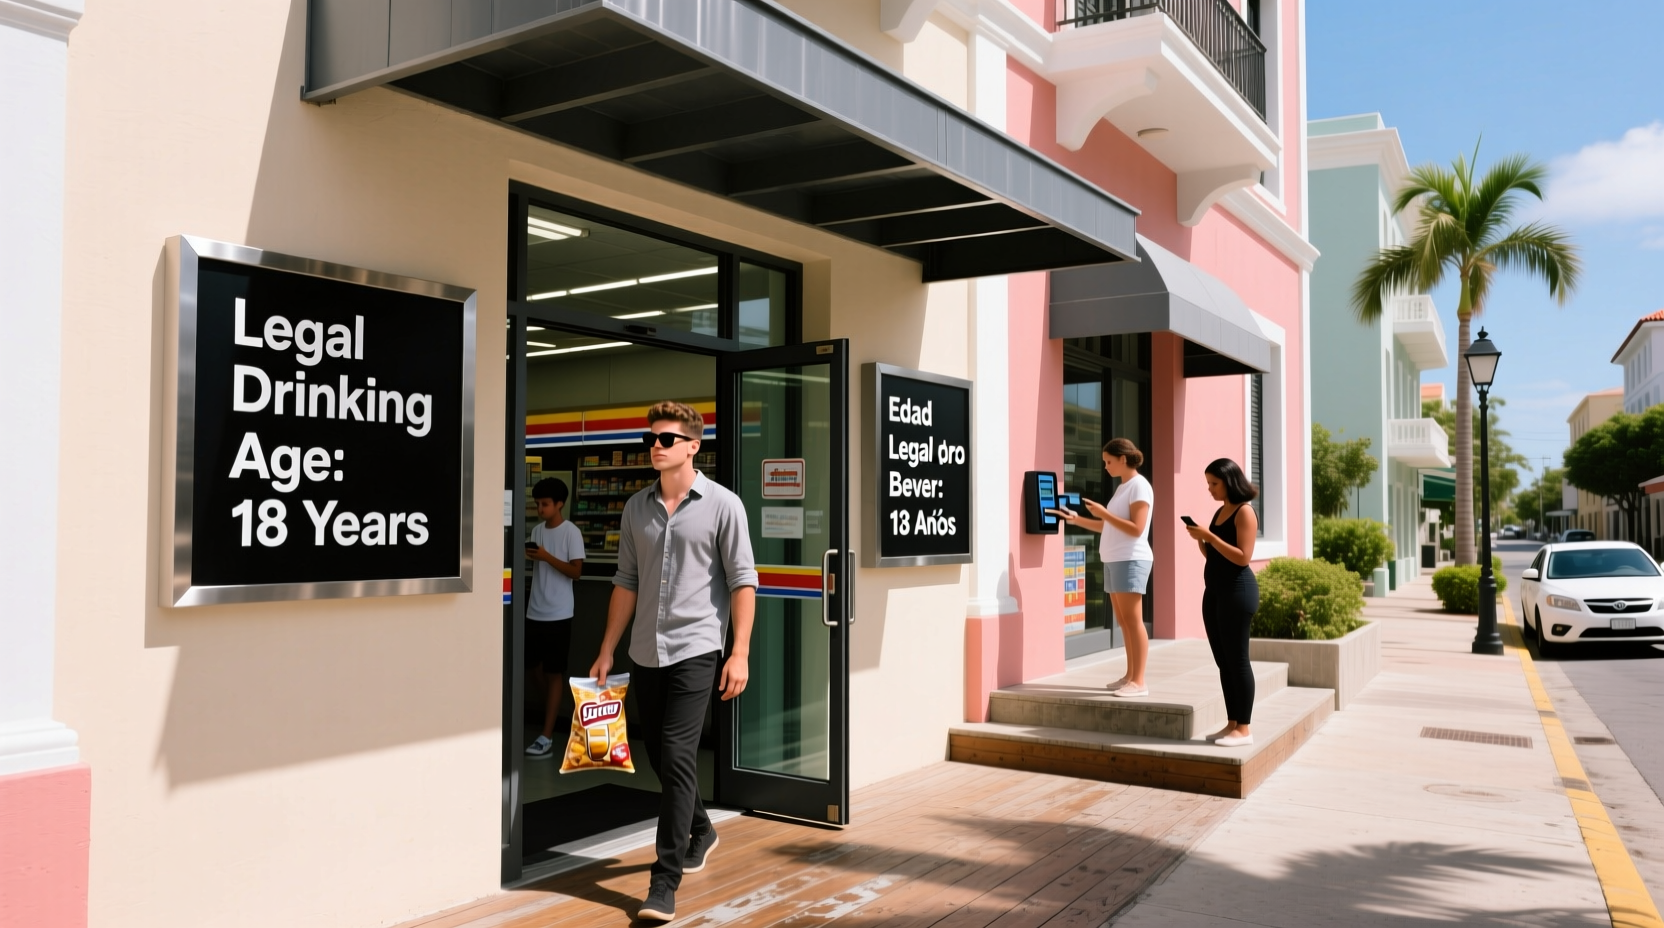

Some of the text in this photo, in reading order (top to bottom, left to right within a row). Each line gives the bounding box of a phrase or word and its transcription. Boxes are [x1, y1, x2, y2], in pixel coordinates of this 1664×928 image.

[234, 297, 365, 367] Legal
[233, 364, 433, 438] Drinking
[888, 395, 933, 427] Edad
[228, 431, 344, 493] Age:
[888, 433, 934, 468] Legal
[888, 470, 944, 499] Bever:
[231, 499, 430, 548] 18 Years
